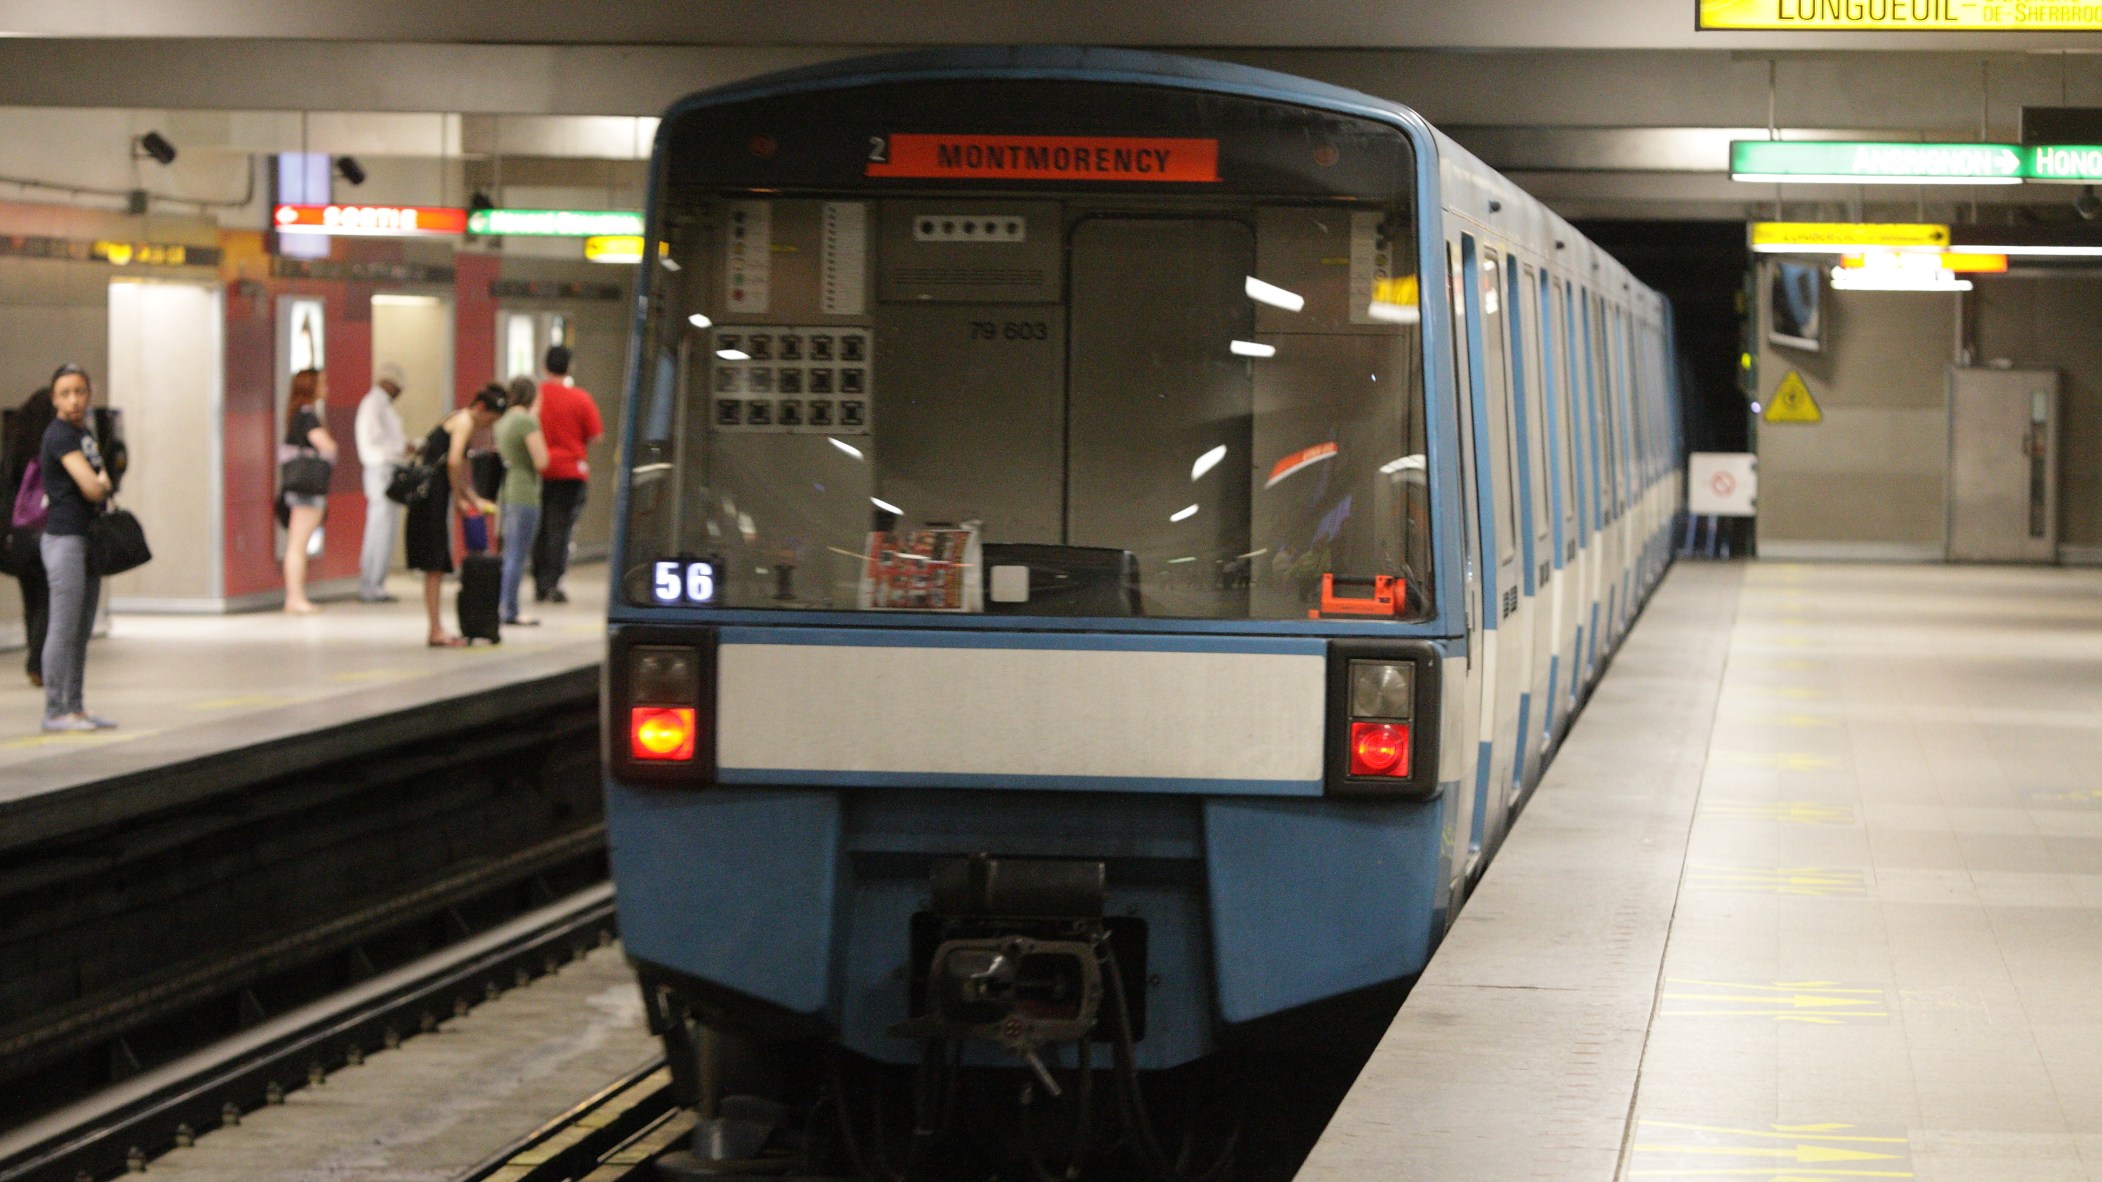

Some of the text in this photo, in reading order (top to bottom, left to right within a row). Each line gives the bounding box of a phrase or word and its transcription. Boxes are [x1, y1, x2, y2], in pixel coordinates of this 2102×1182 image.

[868, 136, 1171, 173] 2 MONTMORENCY
[1004, 321, 1048, 340] 603
[655, 561, 714, 602] 56
